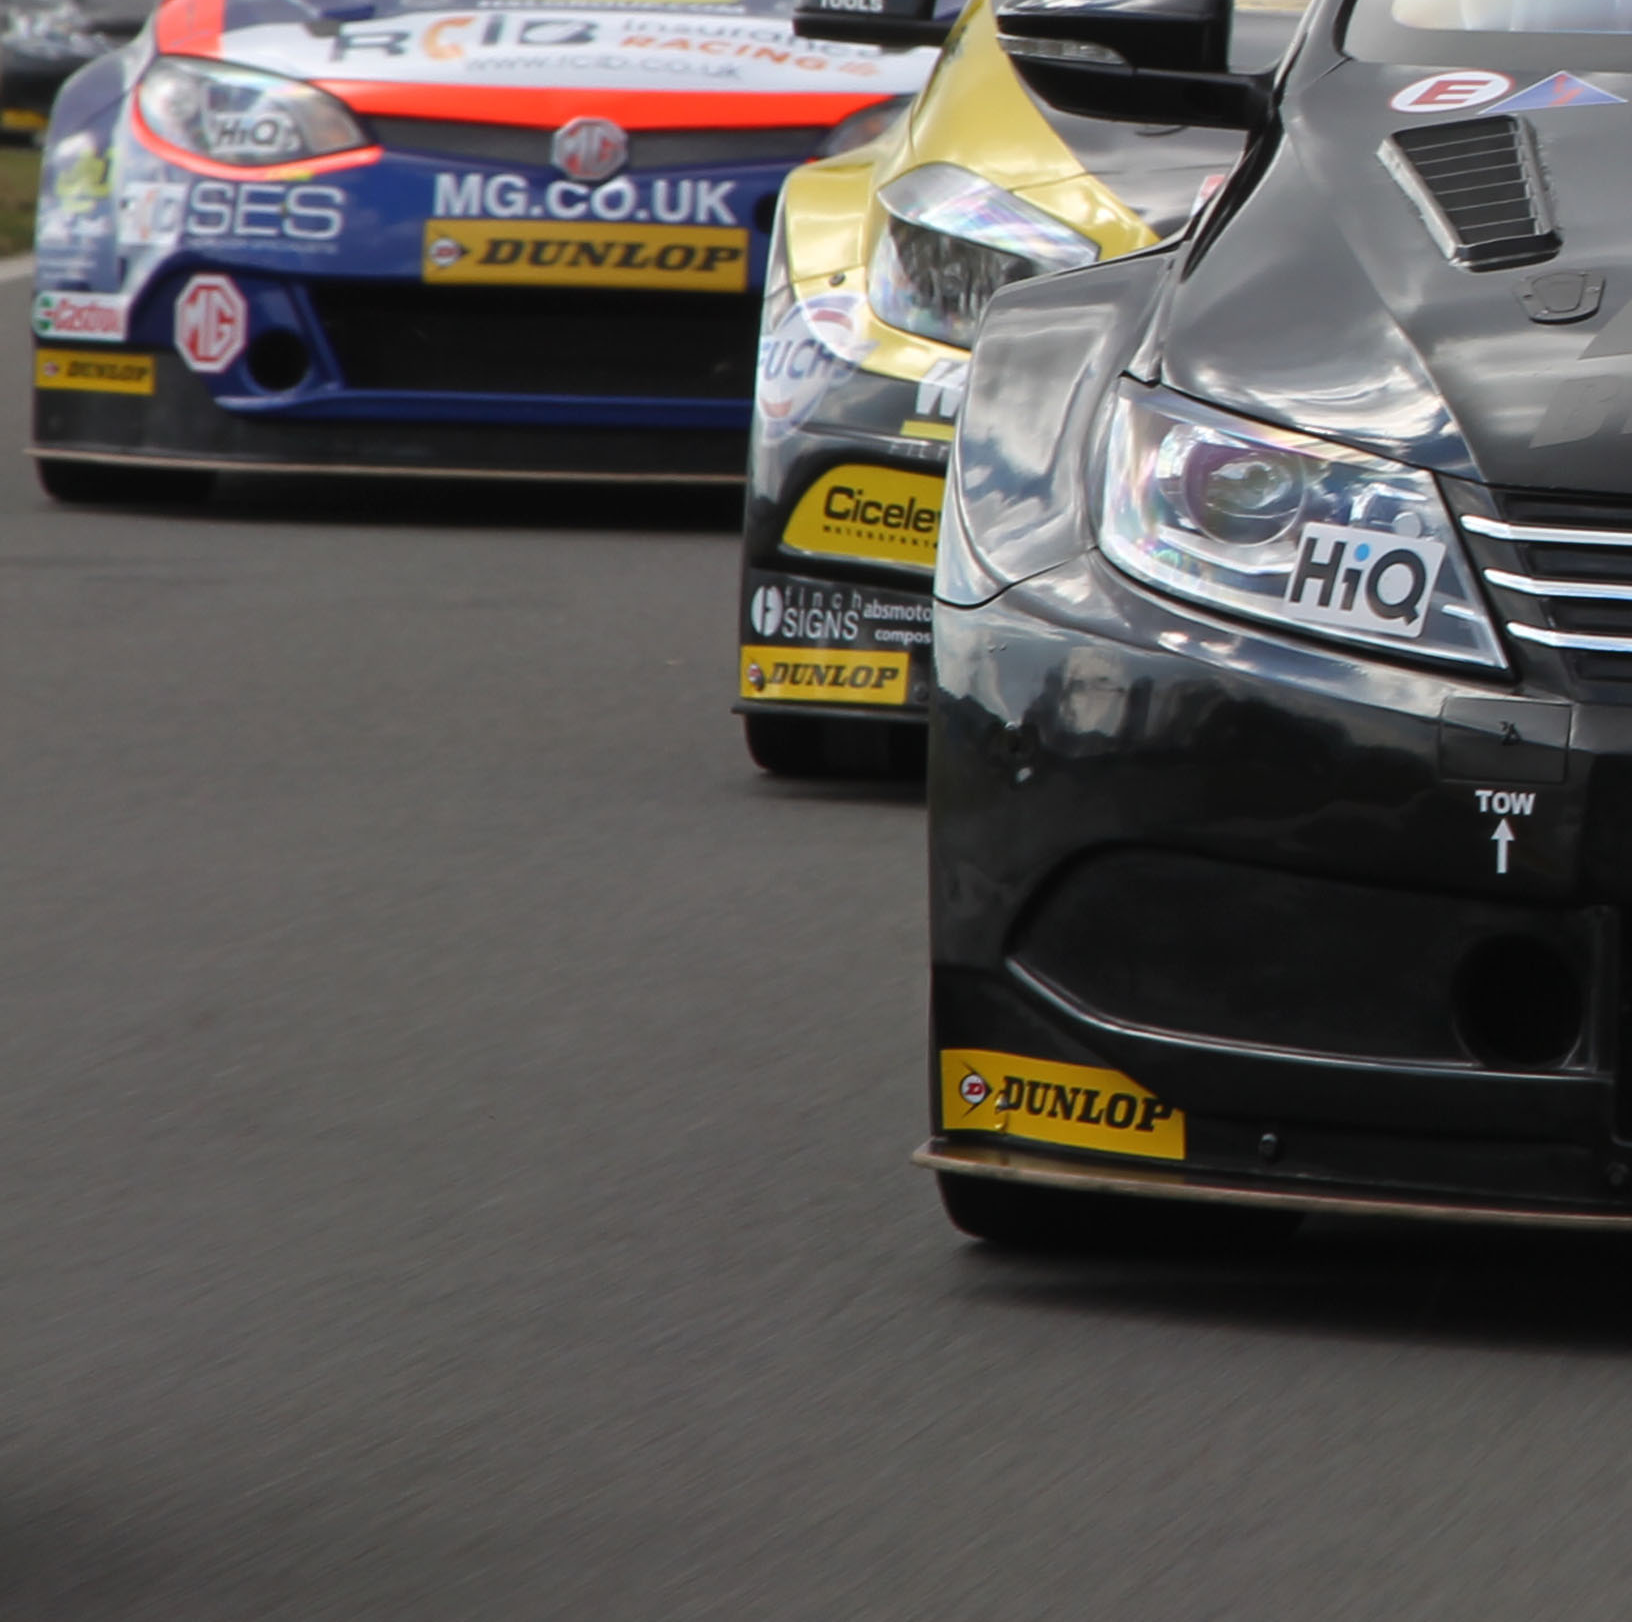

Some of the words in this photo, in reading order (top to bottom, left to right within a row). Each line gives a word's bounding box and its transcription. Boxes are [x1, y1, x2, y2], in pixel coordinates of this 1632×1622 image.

[187, 182, 346, 240] SES
[434, 174, 738, 225] MG.CO.UK
[476, 238, 742, 273] DUNLOP
[824, 485, 942, 534] Cicele
[1289, 536, 1428, 626] HiQ
[864, 599, 934, 622] absmoto
[874, 628, 932, 645] compos
[771, 662, 900, 689] DUNLOP
[1474, 789, 1537, 815] TOW
[1002, 1075, 1177, 1133] DUNLOP
